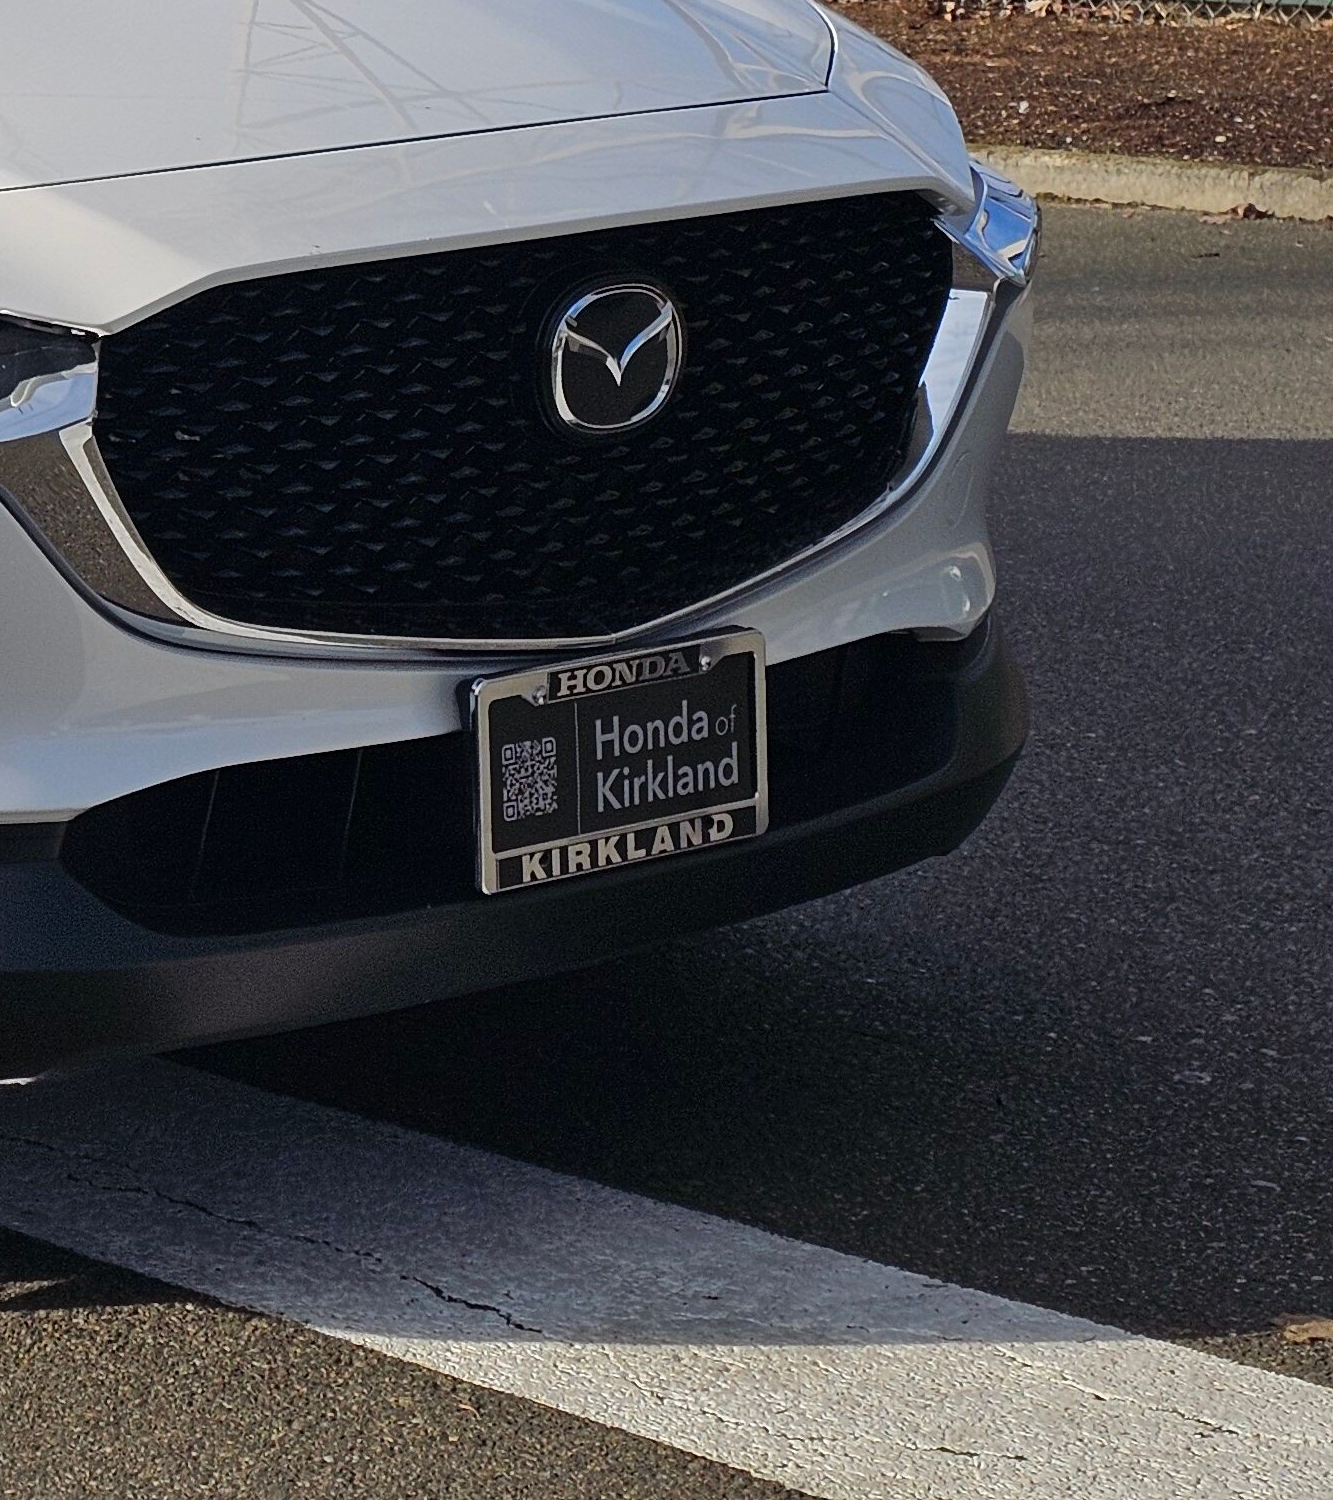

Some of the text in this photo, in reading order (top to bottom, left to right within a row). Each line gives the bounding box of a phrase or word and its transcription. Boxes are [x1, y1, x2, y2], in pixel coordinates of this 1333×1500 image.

[556, 652, 691, 698] HONDA
[595, 700, 738, 761] Honda of
[596, 740, 739, 813] Kirkland
[521, 812, 734, 884] KIRKLAND
